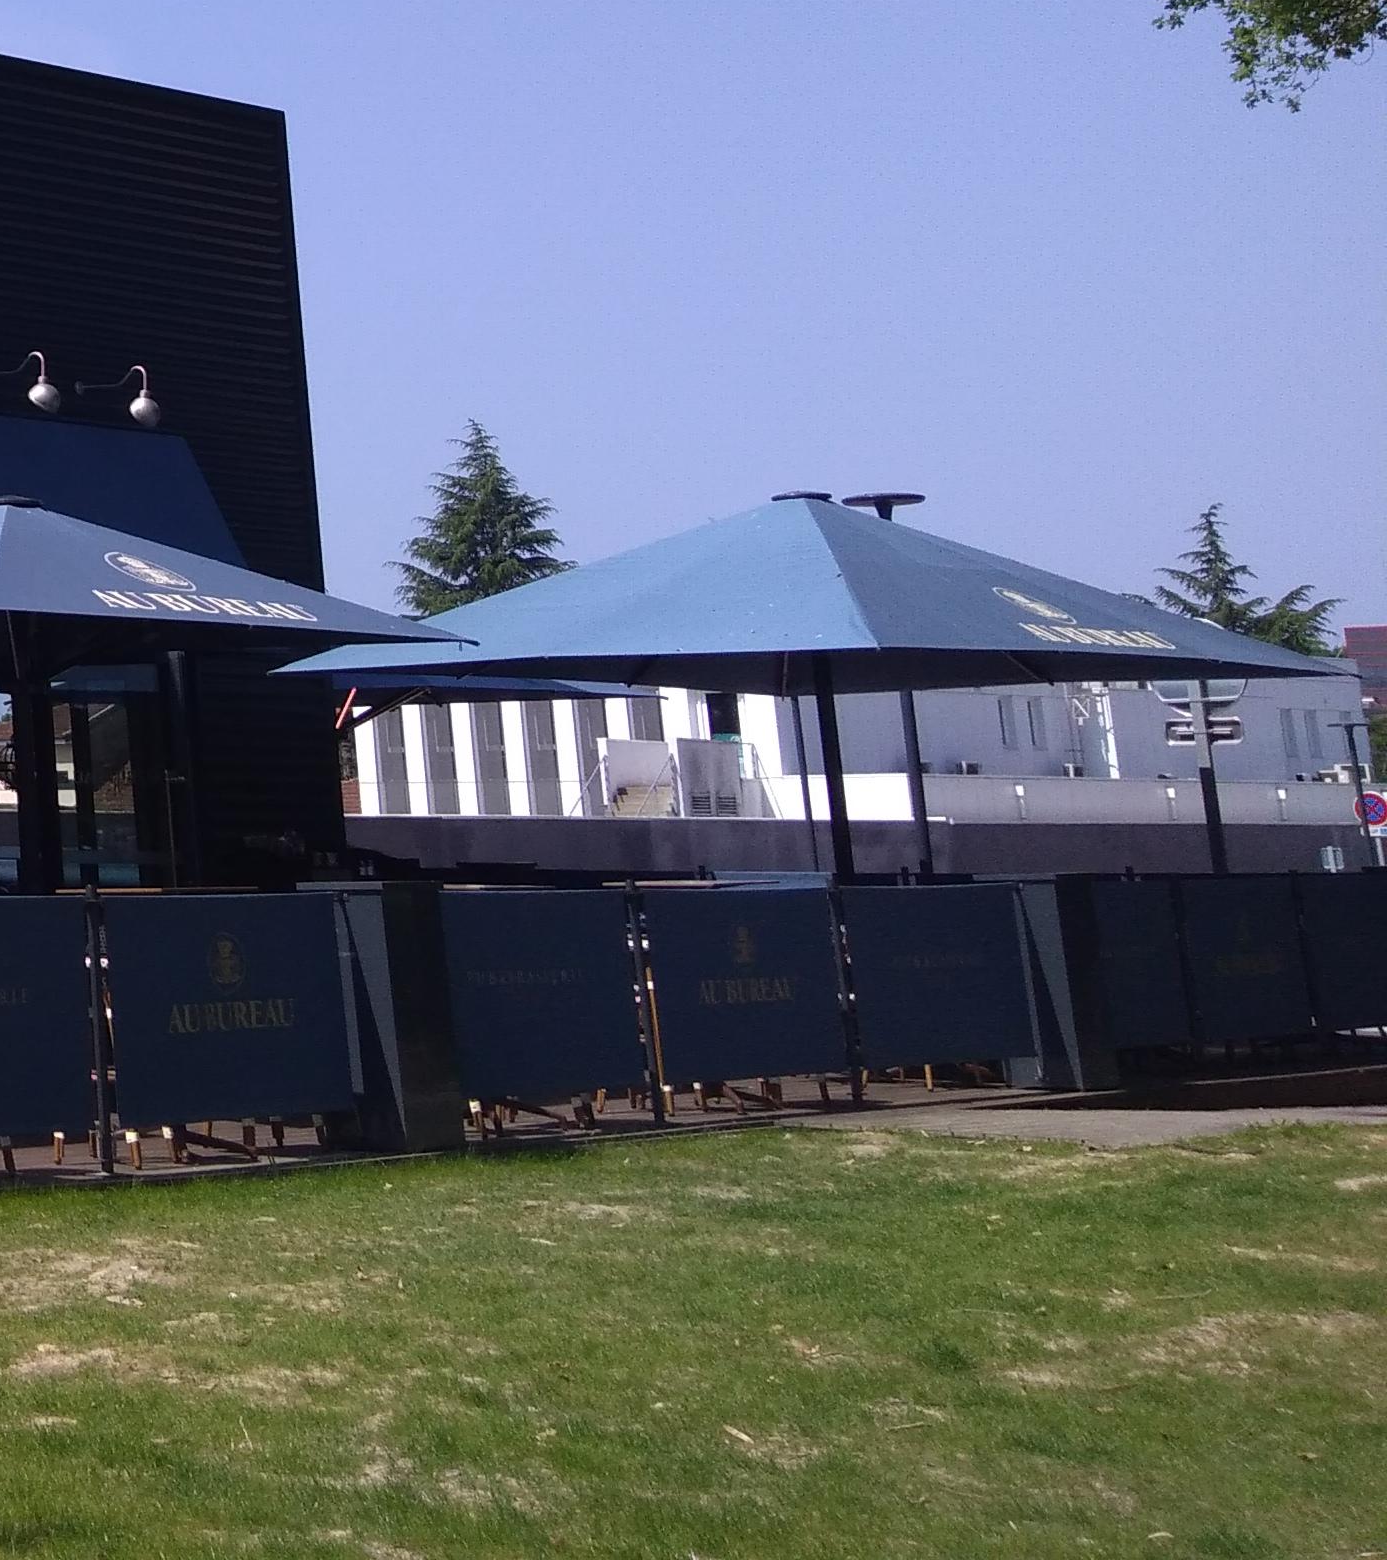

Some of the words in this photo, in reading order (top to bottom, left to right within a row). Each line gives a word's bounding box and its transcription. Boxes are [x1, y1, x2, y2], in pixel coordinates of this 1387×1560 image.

[92, 590, 157, 610] AU
[144, 593, 318, 622] BUREAU
[1017, 622, 1072, 643] AU
[1049, 626, 1177, 649] BUREAU
[699, 978, 723, 1005] AU
[724, 976, 796, 1004] BUREAU
[170, 1002, 200, 1033] AU
[203, 998, 298, 1032] BUREAU
